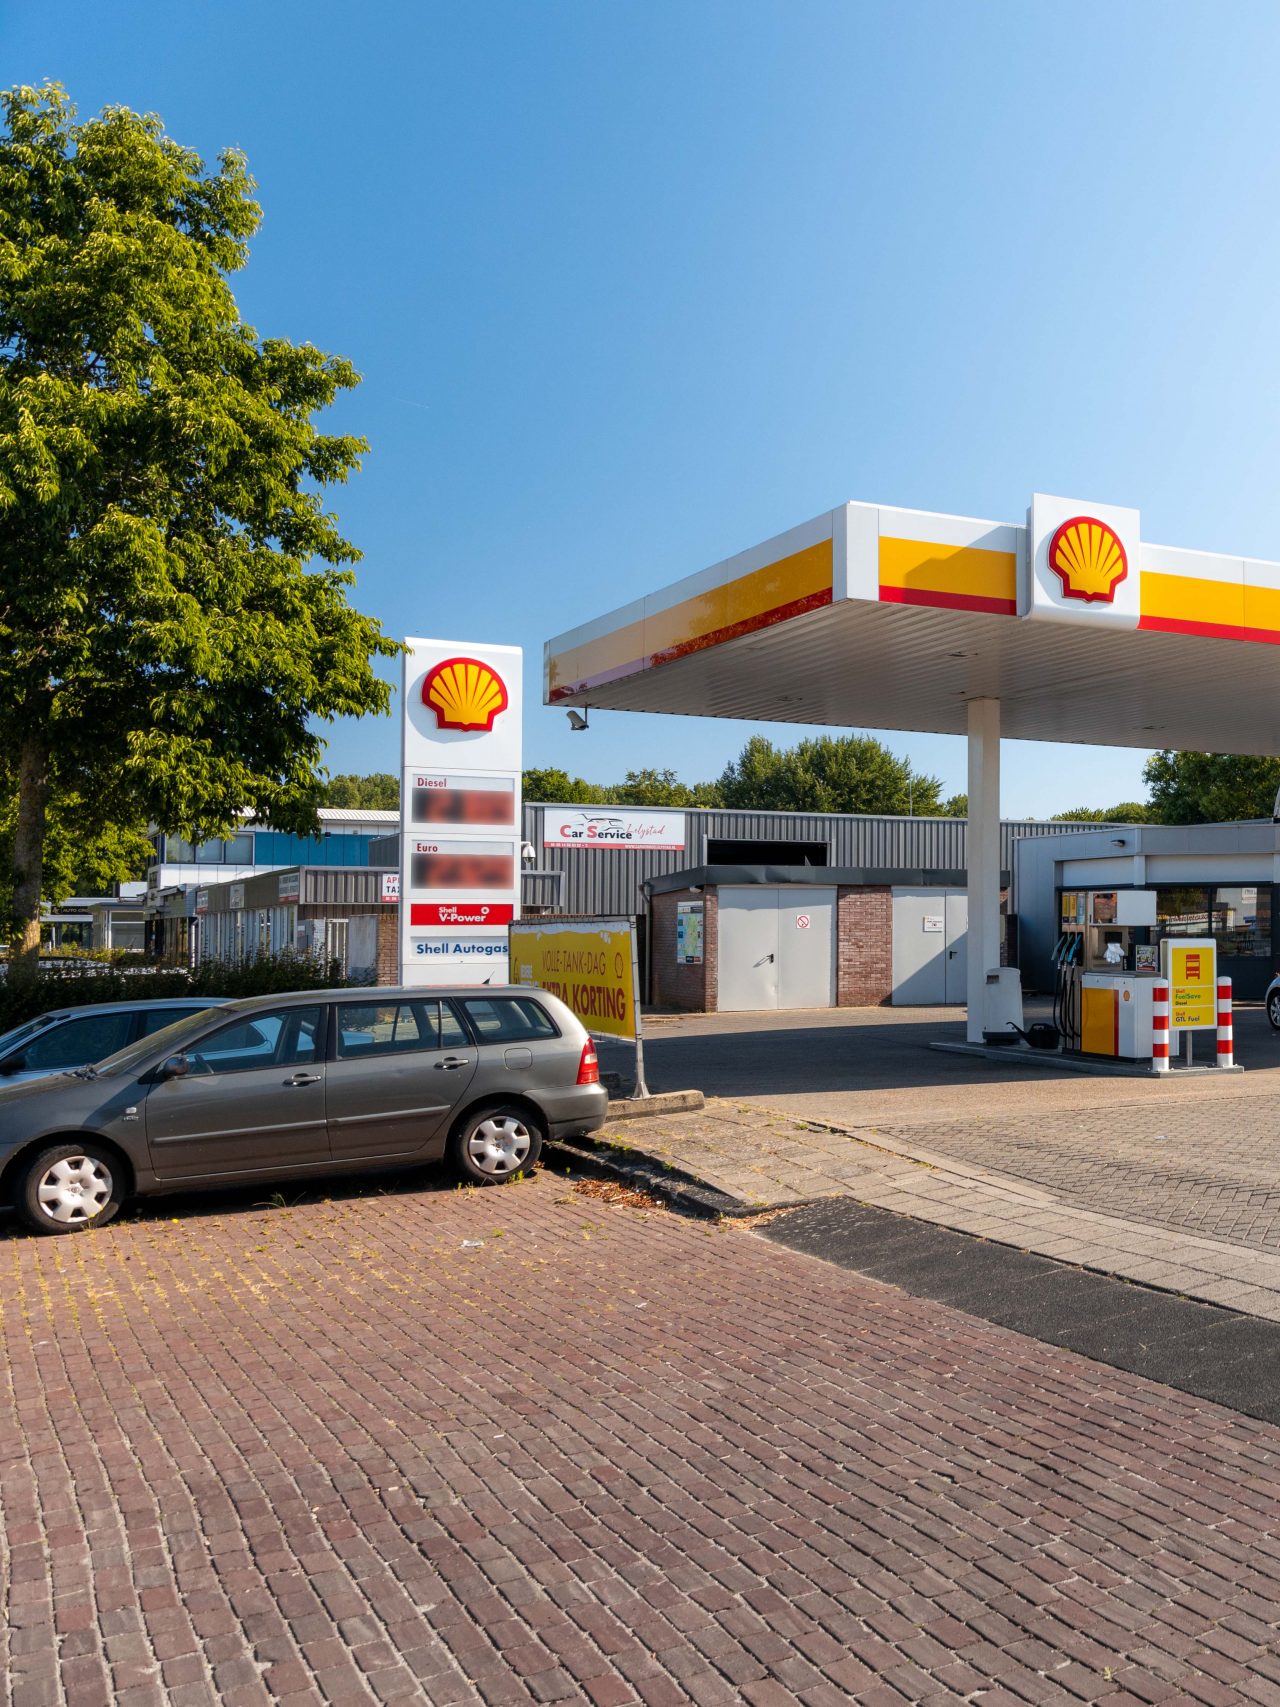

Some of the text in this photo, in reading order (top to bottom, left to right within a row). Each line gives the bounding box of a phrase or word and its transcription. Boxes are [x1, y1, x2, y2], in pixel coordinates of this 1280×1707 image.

[417, 777, 447, 788] Diesel
[560, 825, 583, 838] Car
[587, 825, 633, 839] Service
[416, 843, 438, 853] Euro
[439, 913, 486, 922] V-Power
[416, 943, 508, 955] Shell Autogas
[542, 950, 606, 976] VOLLE-TANK-DAG
[541, 981, 626, 1021] TRA KORTING
